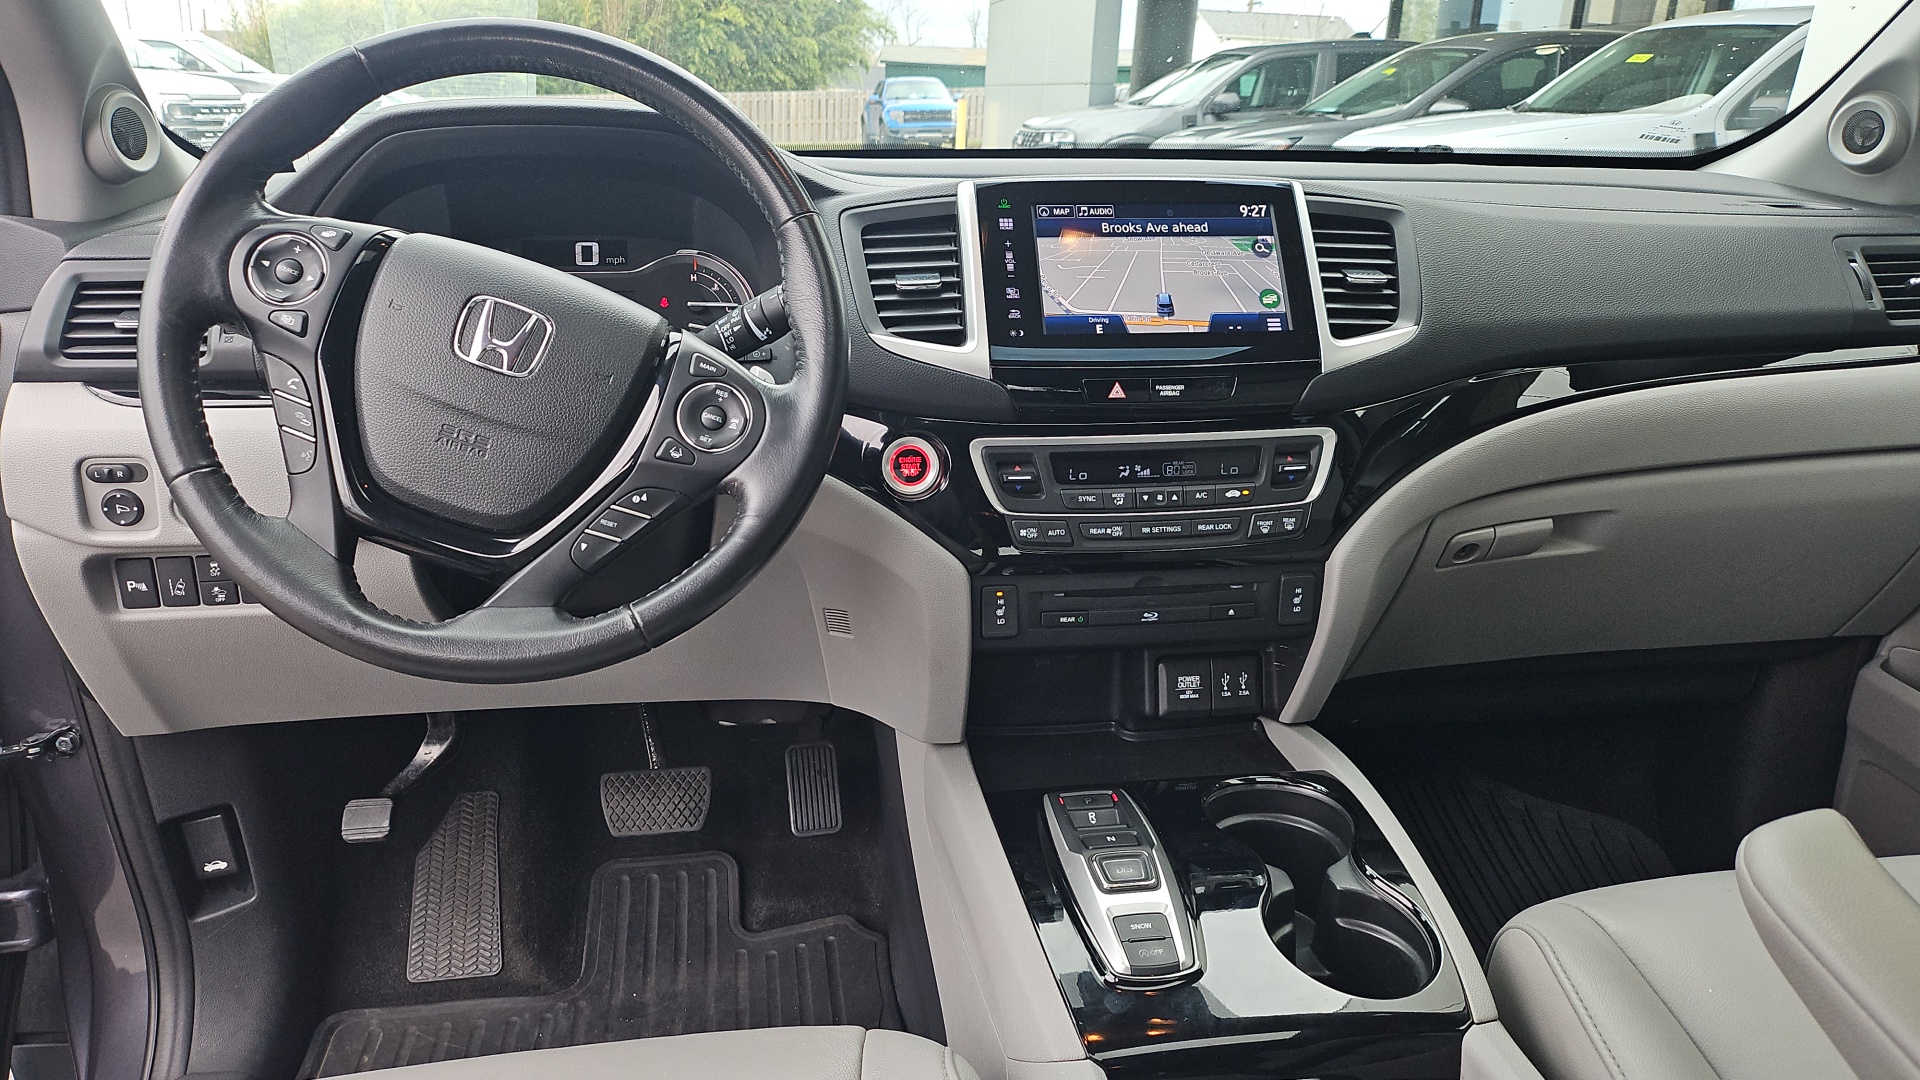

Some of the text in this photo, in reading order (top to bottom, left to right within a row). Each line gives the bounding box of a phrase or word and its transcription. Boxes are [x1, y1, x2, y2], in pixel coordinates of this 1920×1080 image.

[1053, 208, 1070, 216] MAP
[1089, 208, 1113, 216] AUDIO
[1239, 204, 1267, 218] 9:27
[1101, 221, 1209, 234] Brooks Ave ahead
[575, 241, 626, 266] 0 mph
[690, 273, 698, 282] H
[721, 322, 731, 333] OFF
[1096, 324, 1104, 334] E
[723, 329, 733, 338] INT
[726, 336, 734, 344] LO
[699, 362, 717, 373] MAIN
[715, 388, 729, 399] RES
[703, 412, 723, 423] CANCEL
[699, 435, 713, 444] SET
[1166, 465, 1180, 475] 80
[600, 518, 618, 528] RESET
[1151, 525, 1182, 533] SETTINGS
[1088, 812, 1096, 821] R
